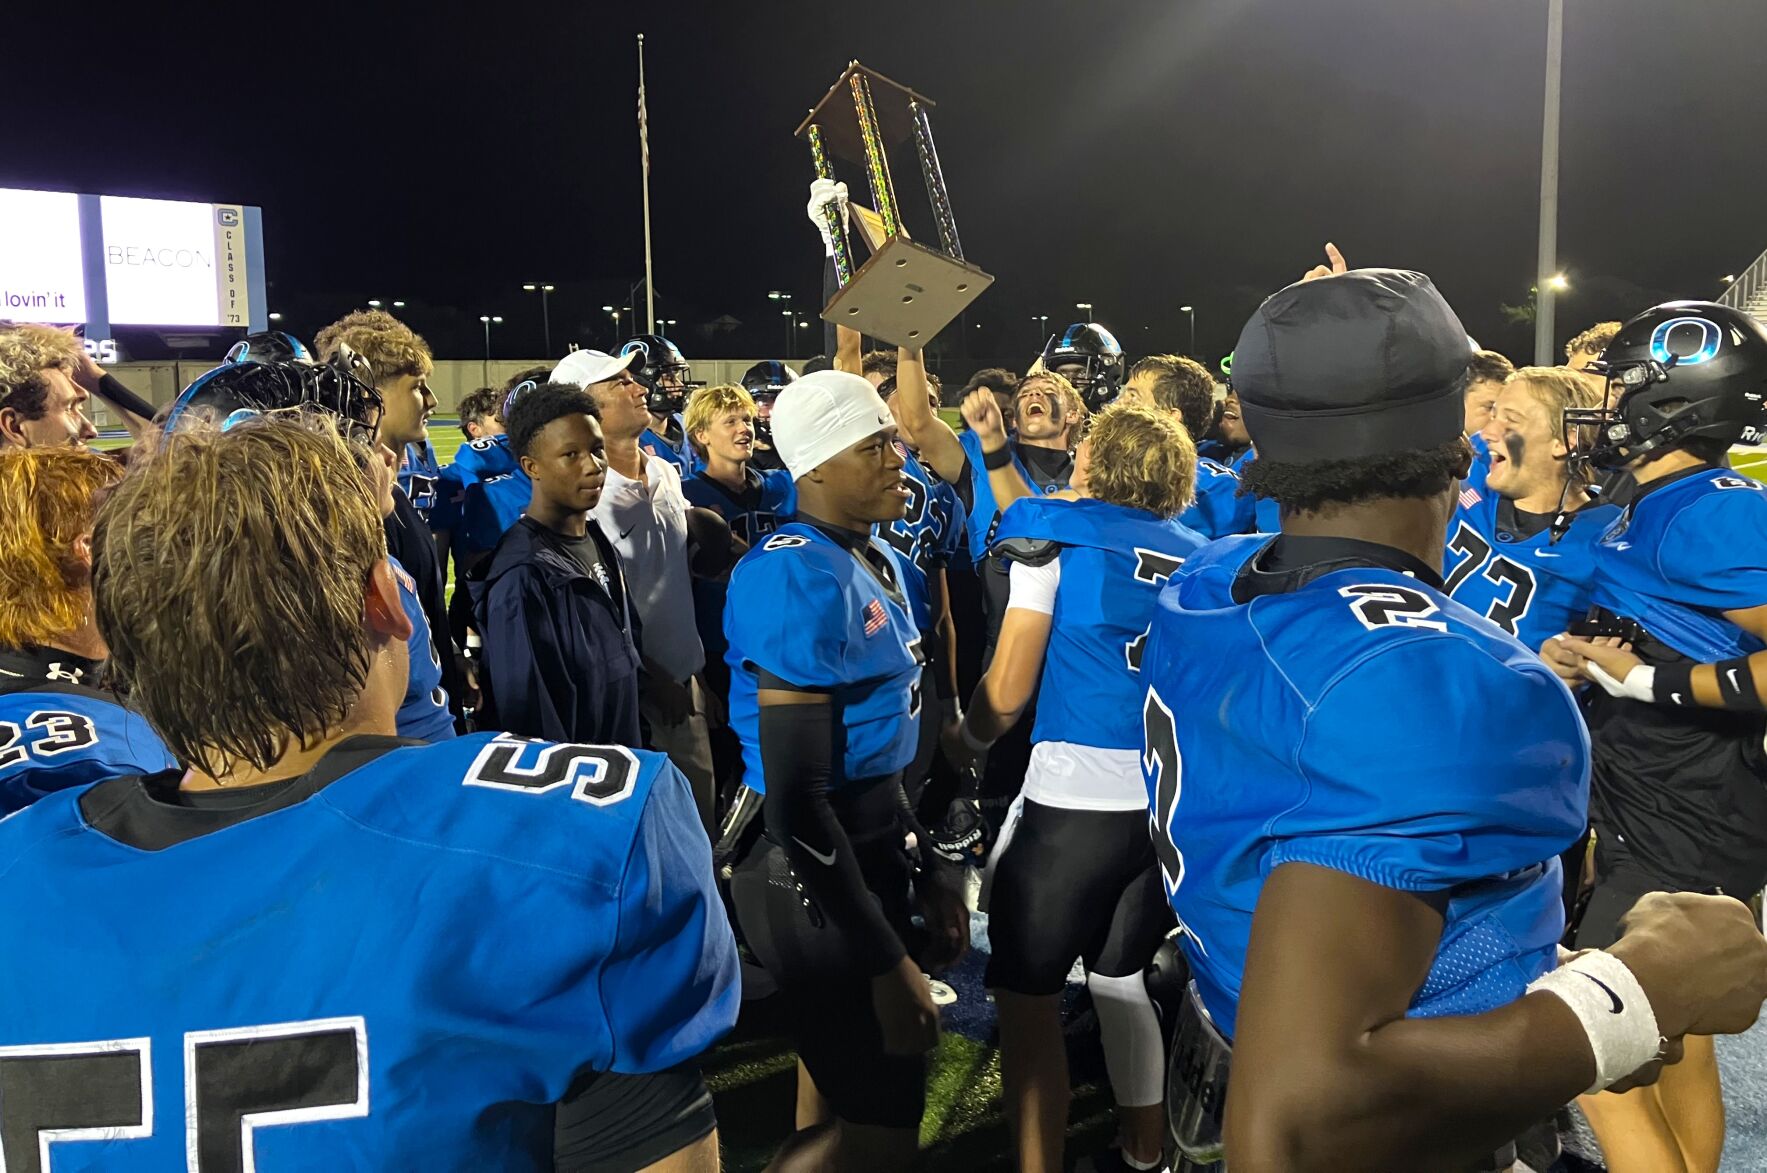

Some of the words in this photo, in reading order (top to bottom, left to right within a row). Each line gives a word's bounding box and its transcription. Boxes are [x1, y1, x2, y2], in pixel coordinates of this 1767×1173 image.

[108, 245, 211, 268] BEACON
[225, 230, 234, 283] CLASS
[5, 290, 50, 308] lovin'
[54, 291, 66, 308] it
[229, 289, 235, 309] OF
[227, 314, 240, 324] '73
[1442, 518, 1538, 638] 73
[937, 828, 983, 851] Riddell
